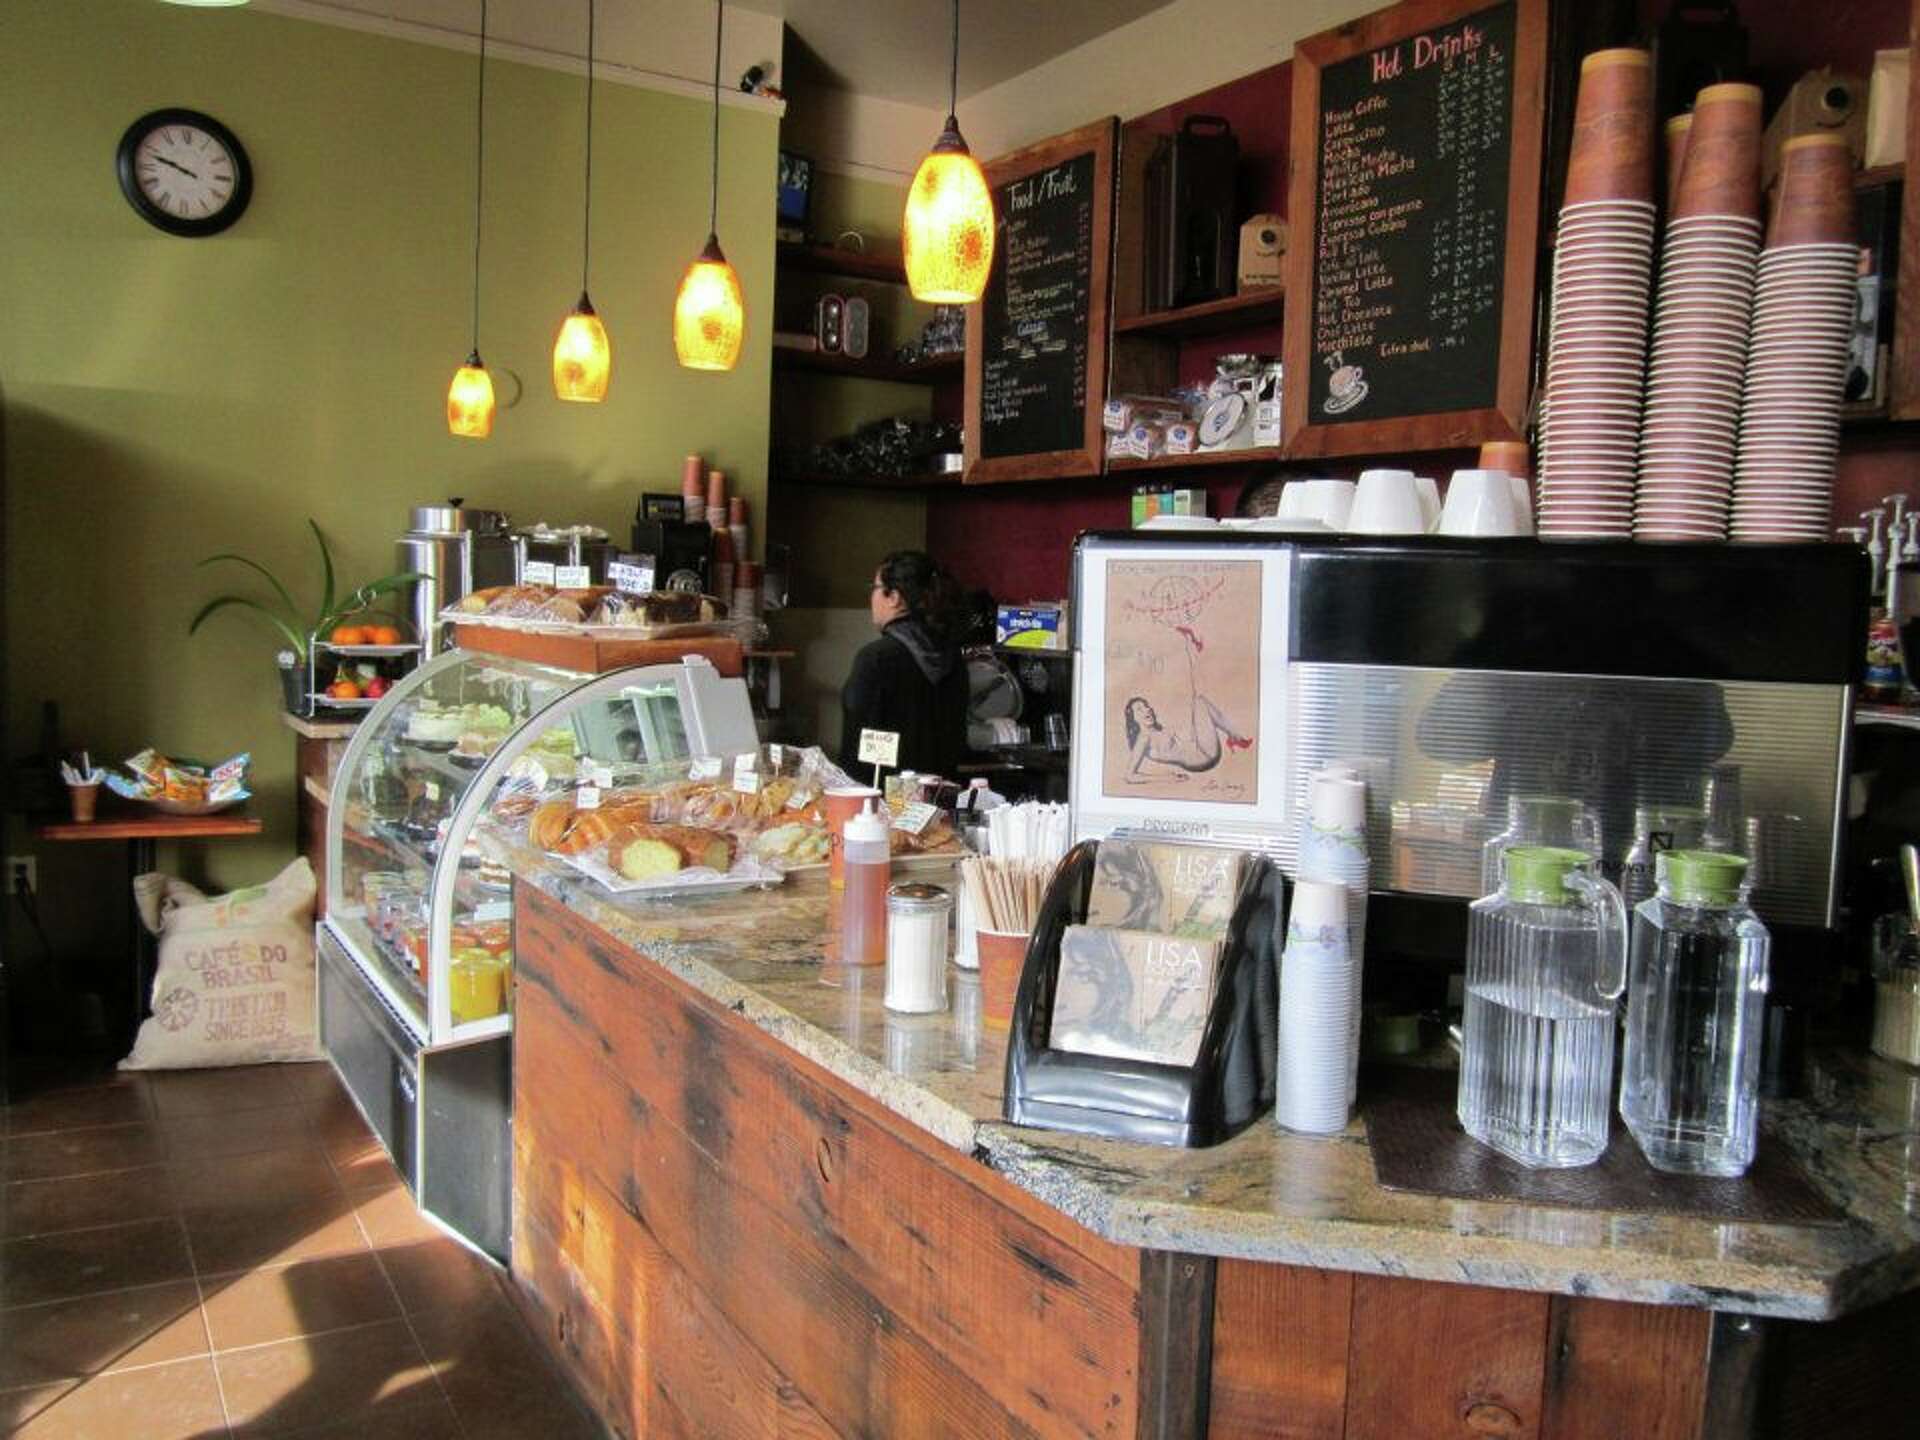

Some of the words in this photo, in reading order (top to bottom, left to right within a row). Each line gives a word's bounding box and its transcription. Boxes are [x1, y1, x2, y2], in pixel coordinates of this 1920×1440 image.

[1413, 25, 1483, 69] Drinks
[1376, 154, 1416, 177] Mocha
[1364, 275, 1394, 292] Latte
[1175, 853, 1229, 881] LISA
[260, 944, 288, 963] DO
[1146, 938, 1203, 969] LISA
[202, 964, 274, 988] BRASIL
